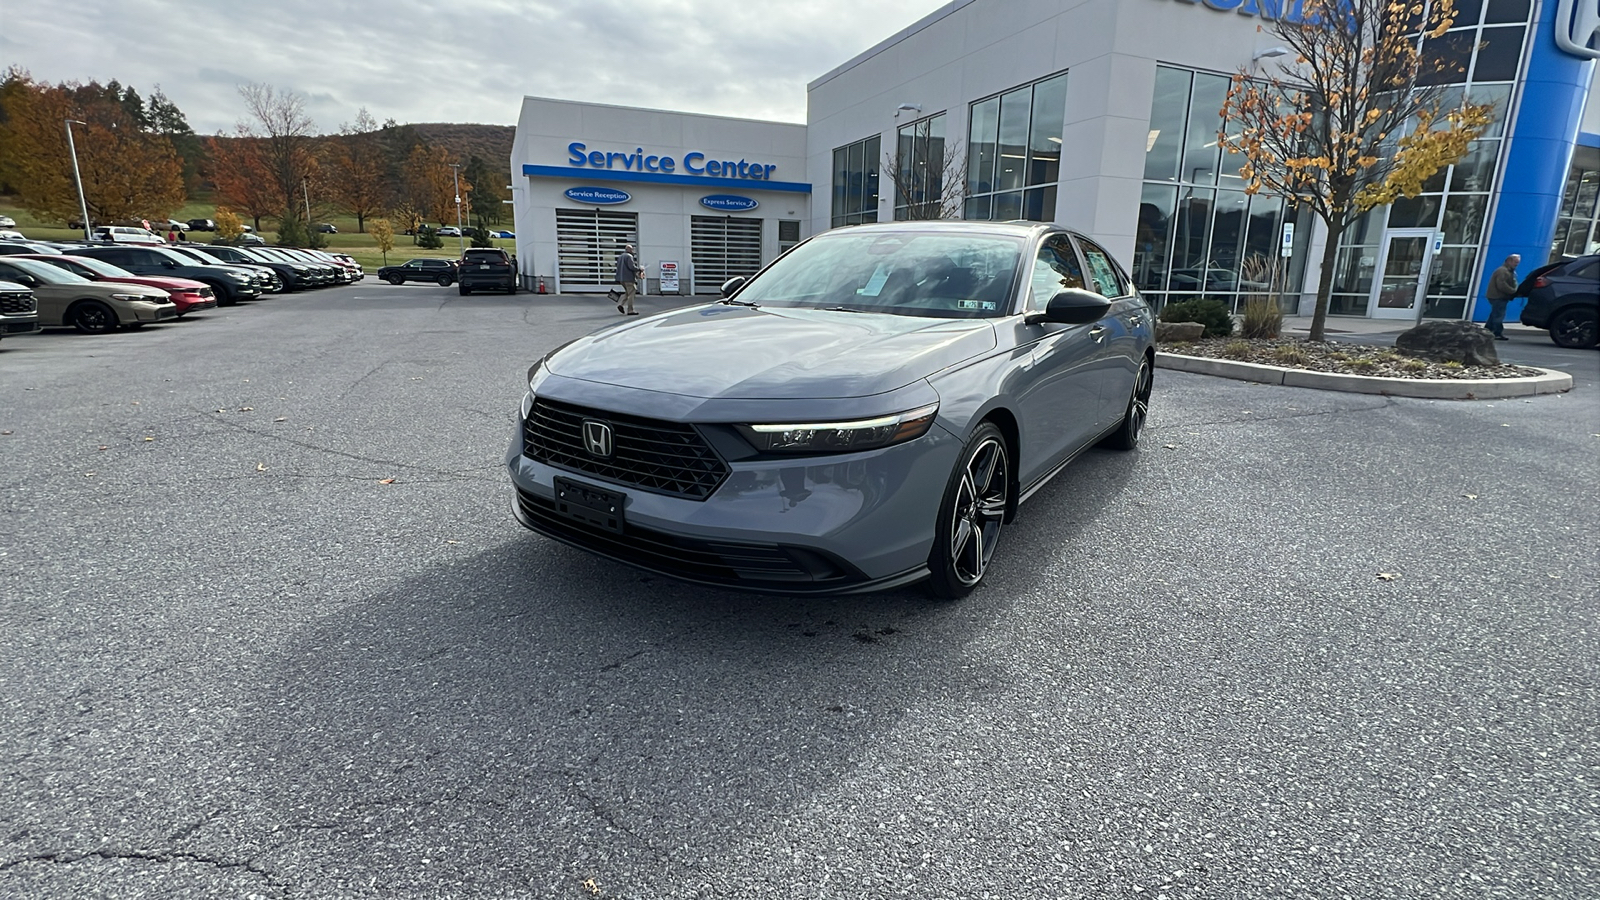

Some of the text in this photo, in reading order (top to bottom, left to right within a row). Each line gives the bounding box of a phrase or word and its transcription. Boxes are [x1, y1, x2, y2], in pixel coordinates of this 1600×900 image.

[568, 142, 776, 180] Service Center
[594, 191, 627, 200] Reception
[703, 198, 725, 206] Express
